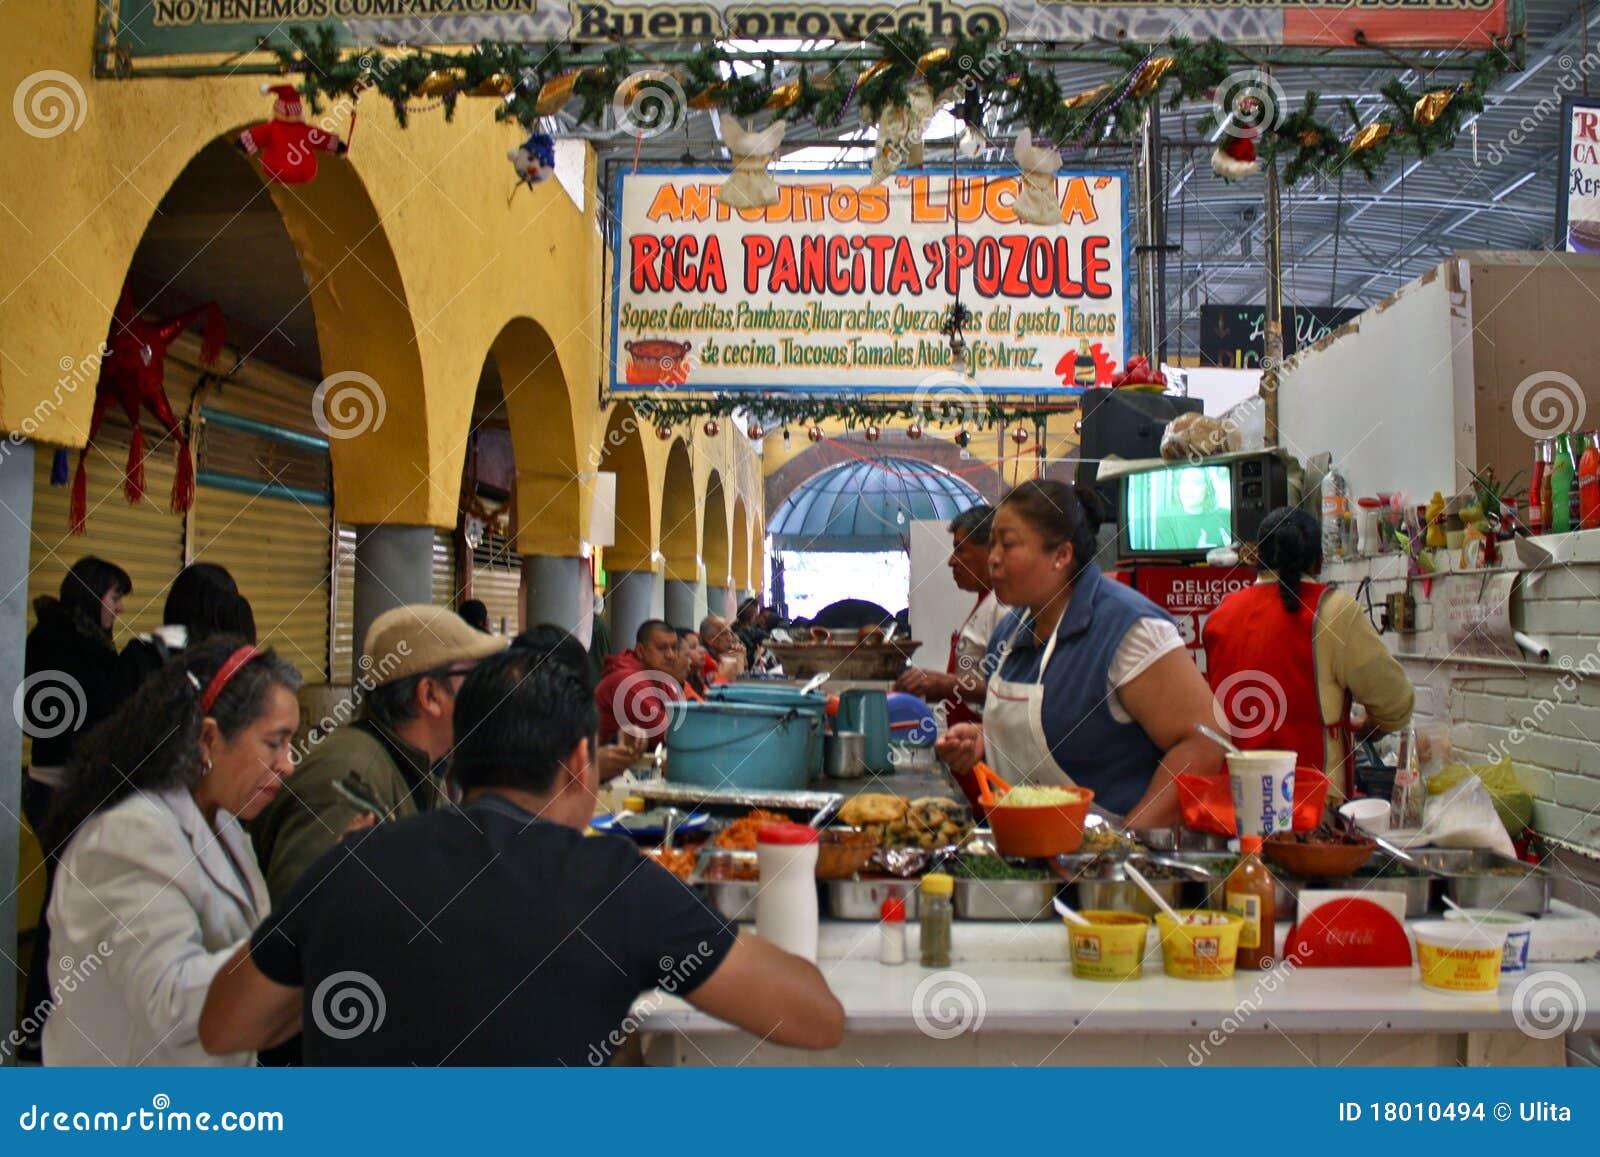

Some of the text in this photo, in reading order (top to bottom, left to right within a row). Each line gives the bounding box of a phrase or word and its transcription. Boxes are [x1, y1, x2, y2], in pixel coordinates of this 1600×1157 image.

[156, 0, 196, 22] NO
[203, 0, 329, 18] TENEMOS
[576, 0, 1005, 41] Buen provecho
[894, 175, 1112, 225] "LUCA"
[922, 241, 944, 289] y
[942, 235, 1112, 299] POZOLE
[988, 305, 1012, 333] del
[1064, 305, 1117, 336] Tacos
[700, 337, 720, 368] de
[962, 340, 989, 379] afé
[1172, 580, 1250, 594] DELICIOS
